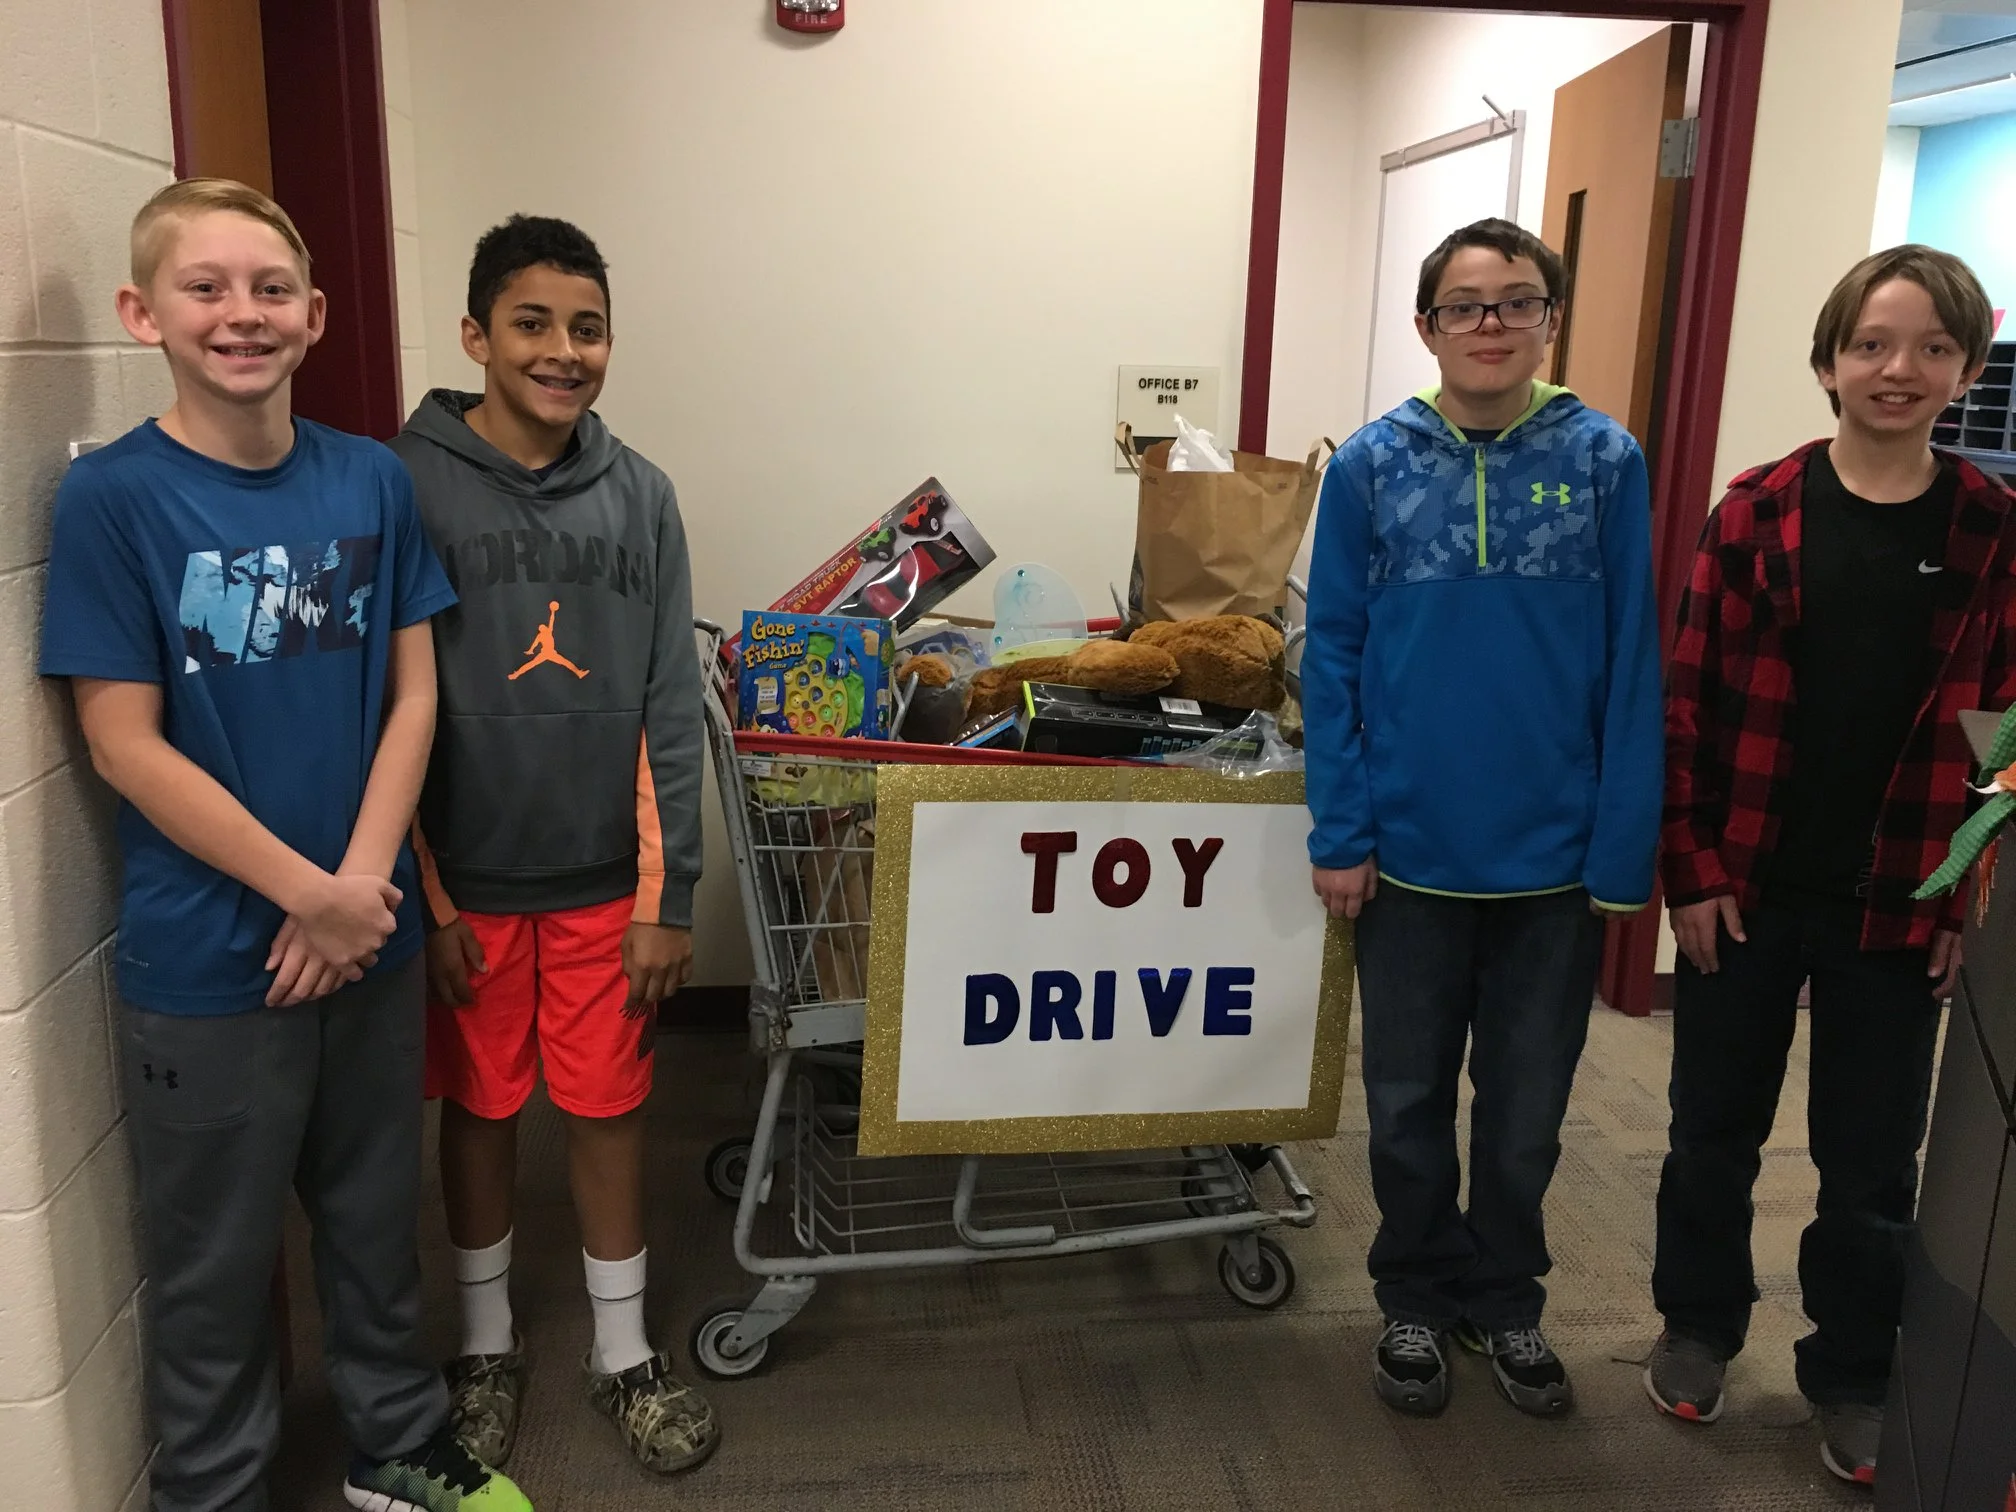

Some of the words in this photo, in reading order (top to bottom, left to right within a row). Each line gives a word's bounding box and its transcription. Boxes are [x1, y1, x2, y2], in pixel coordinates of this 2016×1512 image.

[794, 13, 828, 25] FIRE
[1138, 377, 1180, 390] OFFICE
[1184, 379, 1199, 390] B7
[1157, 394, 1178, 405] B118
[793, 590, 815, 611] SVT
[814, 557, 857, 594] RAPTOR
[751, 615, 796, 641] Gone
[742, 638, 805, 670] Fishin'
[768, 662, 787, 670] Game
[1020, 831, 1224, 914] TOY
[963, 967, 1255, 1046] DRIVE
